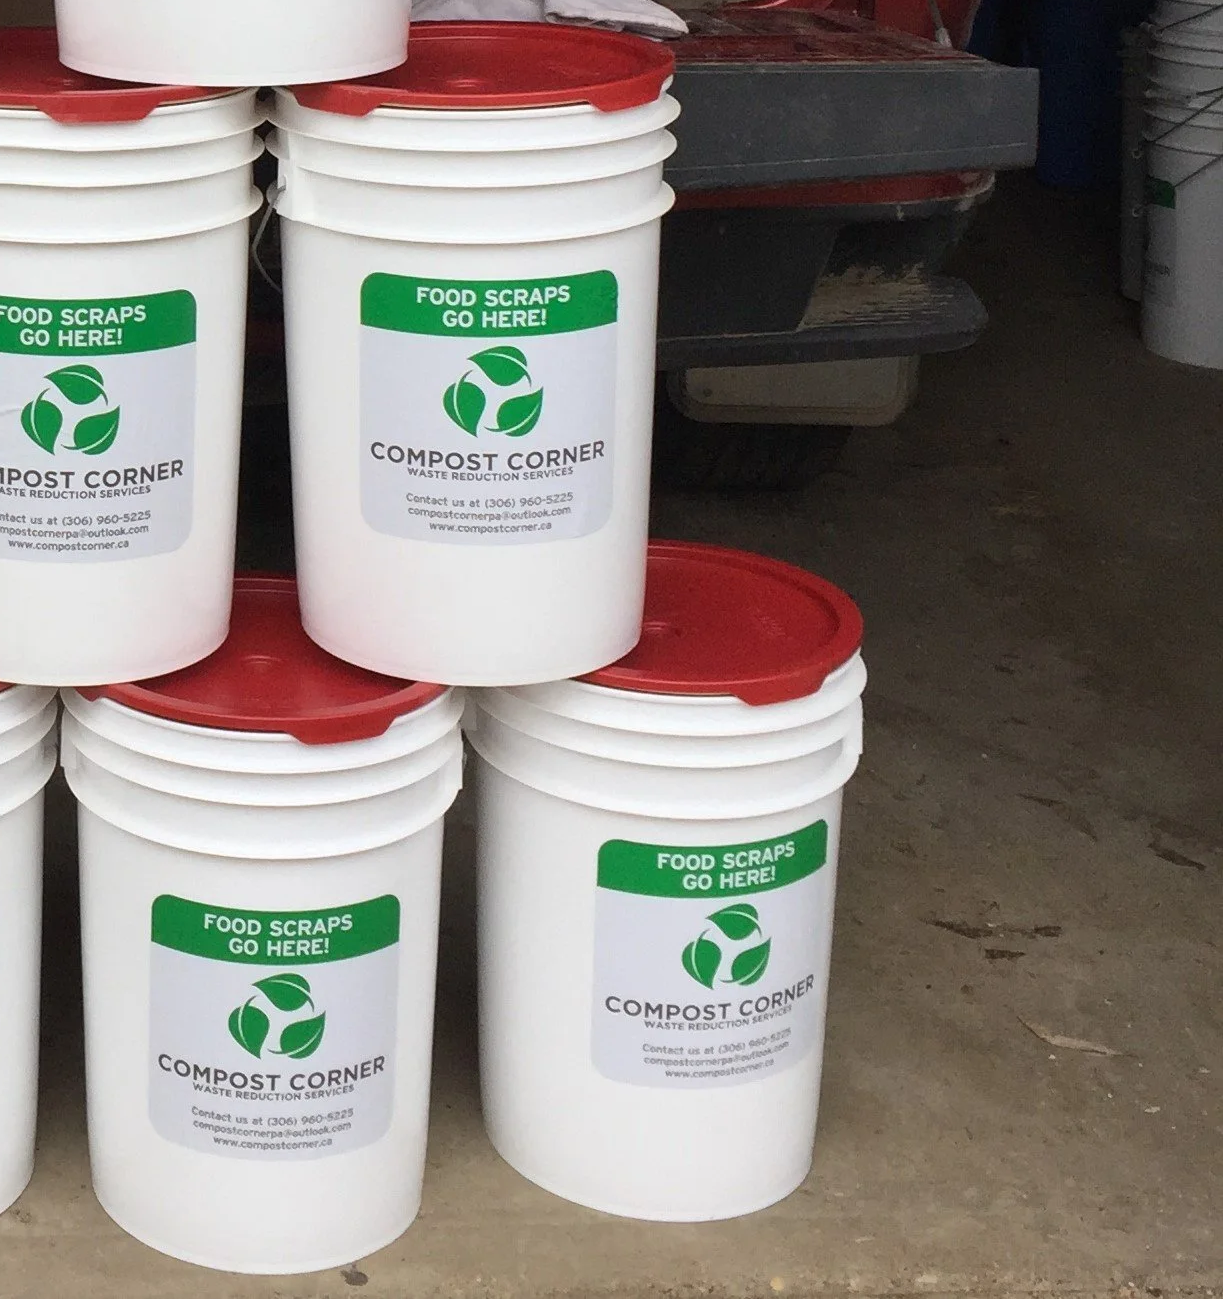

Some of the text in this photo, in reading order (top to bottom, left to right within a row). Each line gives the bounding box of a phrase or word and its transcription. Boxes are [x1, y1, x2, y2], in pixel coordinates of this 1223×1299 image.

[417, 286, 570, 306] FOOD SCRAPS
[61, 305, 146, 325] SCRAPS
[443, 309, 546, 328] GO HERE!
[20, 328, 122, 347] GO HERE!
[371, 441, 604, 471] COMPOST CORNER
[84, 459, 183, 488] CORNER
[408, 467, 574, 481] WASTE REDUCTION SERVICES
[30, 489, 96, 499] REDUCTION
[100, 485, 151, 498] SERVICES
[406, 492, 573, 509] Contact us at (306) 960-5225
[30, 517, 42, 525] us
[47, 516, 57, 525] at
[62, 516, 93, 526] (306)
[97, 511, 151, 525] 960-5225
[429, 522, 552, 534] www.compostcorner.ca
[8, 539, 129, 551] www.compostcorner.ca
[658, 841, 795, 871] FOOD SCRAPS
[683, 866, 776, 890] GO HERE!
[204, 914, 353, 937] FOOD SCRAPS
[229, 938, 329, 957] GO HERE!
[605, 974, 814, 1021] COMPOST CORNER
[645, 1018, 749, 1031] WASTE REDUCTION
[643, 1044, 715, 1056] Contact us at
[158, 1054, 385, 1091] COMPOST CORNER
[193, 1082, 354, 1101] WASTE REDUCTION SERVICES
[192, 1106, 263, 1126] Contact us at
